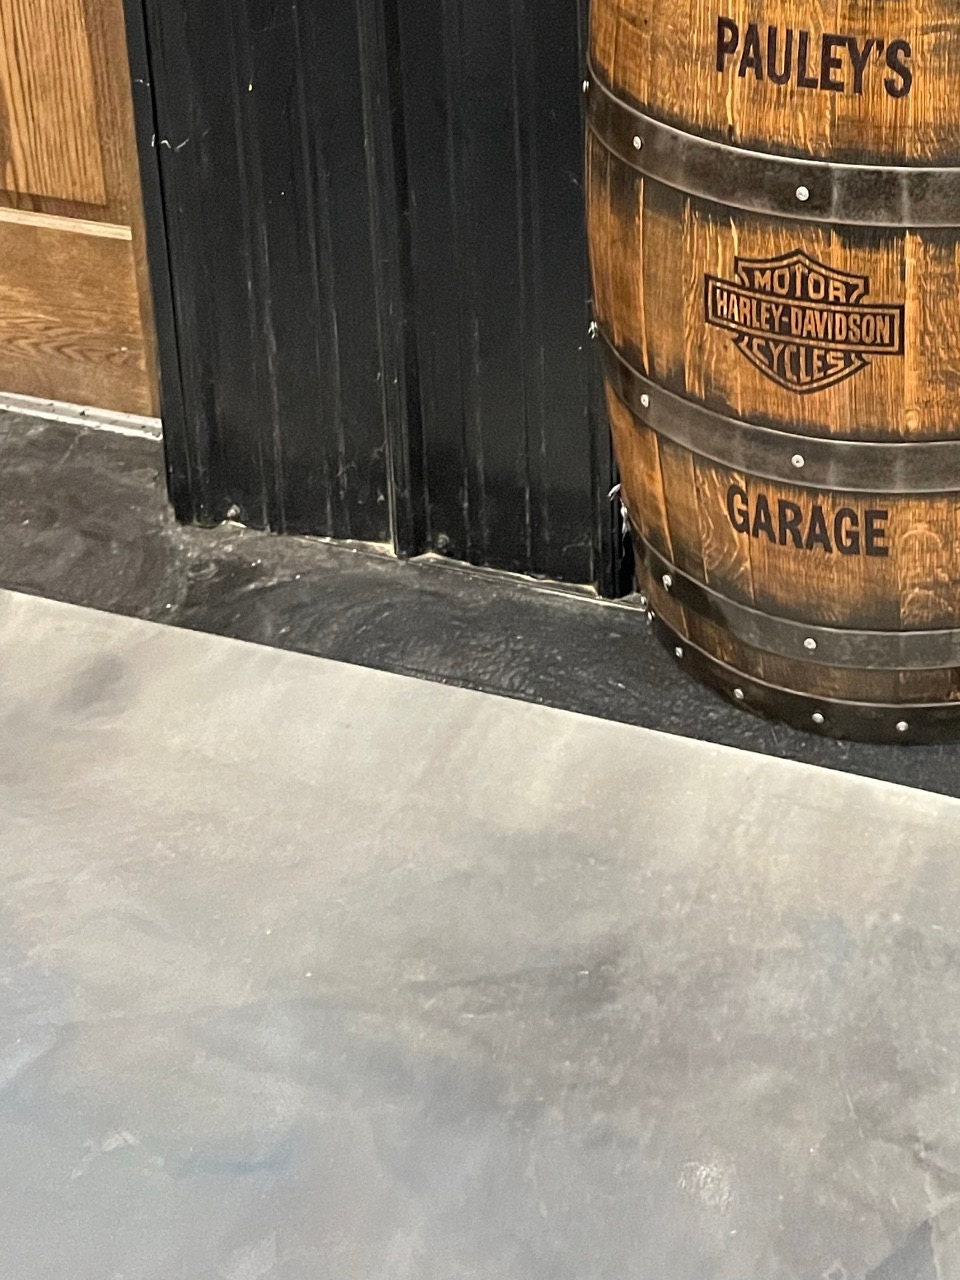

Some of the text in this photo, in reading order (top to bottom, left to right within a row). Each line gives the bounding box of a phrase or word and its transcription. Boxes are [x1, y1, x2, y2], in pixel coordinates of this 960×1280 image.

[716, 16, 913, 99] PAULEY'S
[754, 264, 846, 304] MOTOR
[716, 288, 891, 345] HARLEY-DAVIDSON
[752, 338, 845, 383] CYCLES
[727, 484, 889, 557] GARAGE
